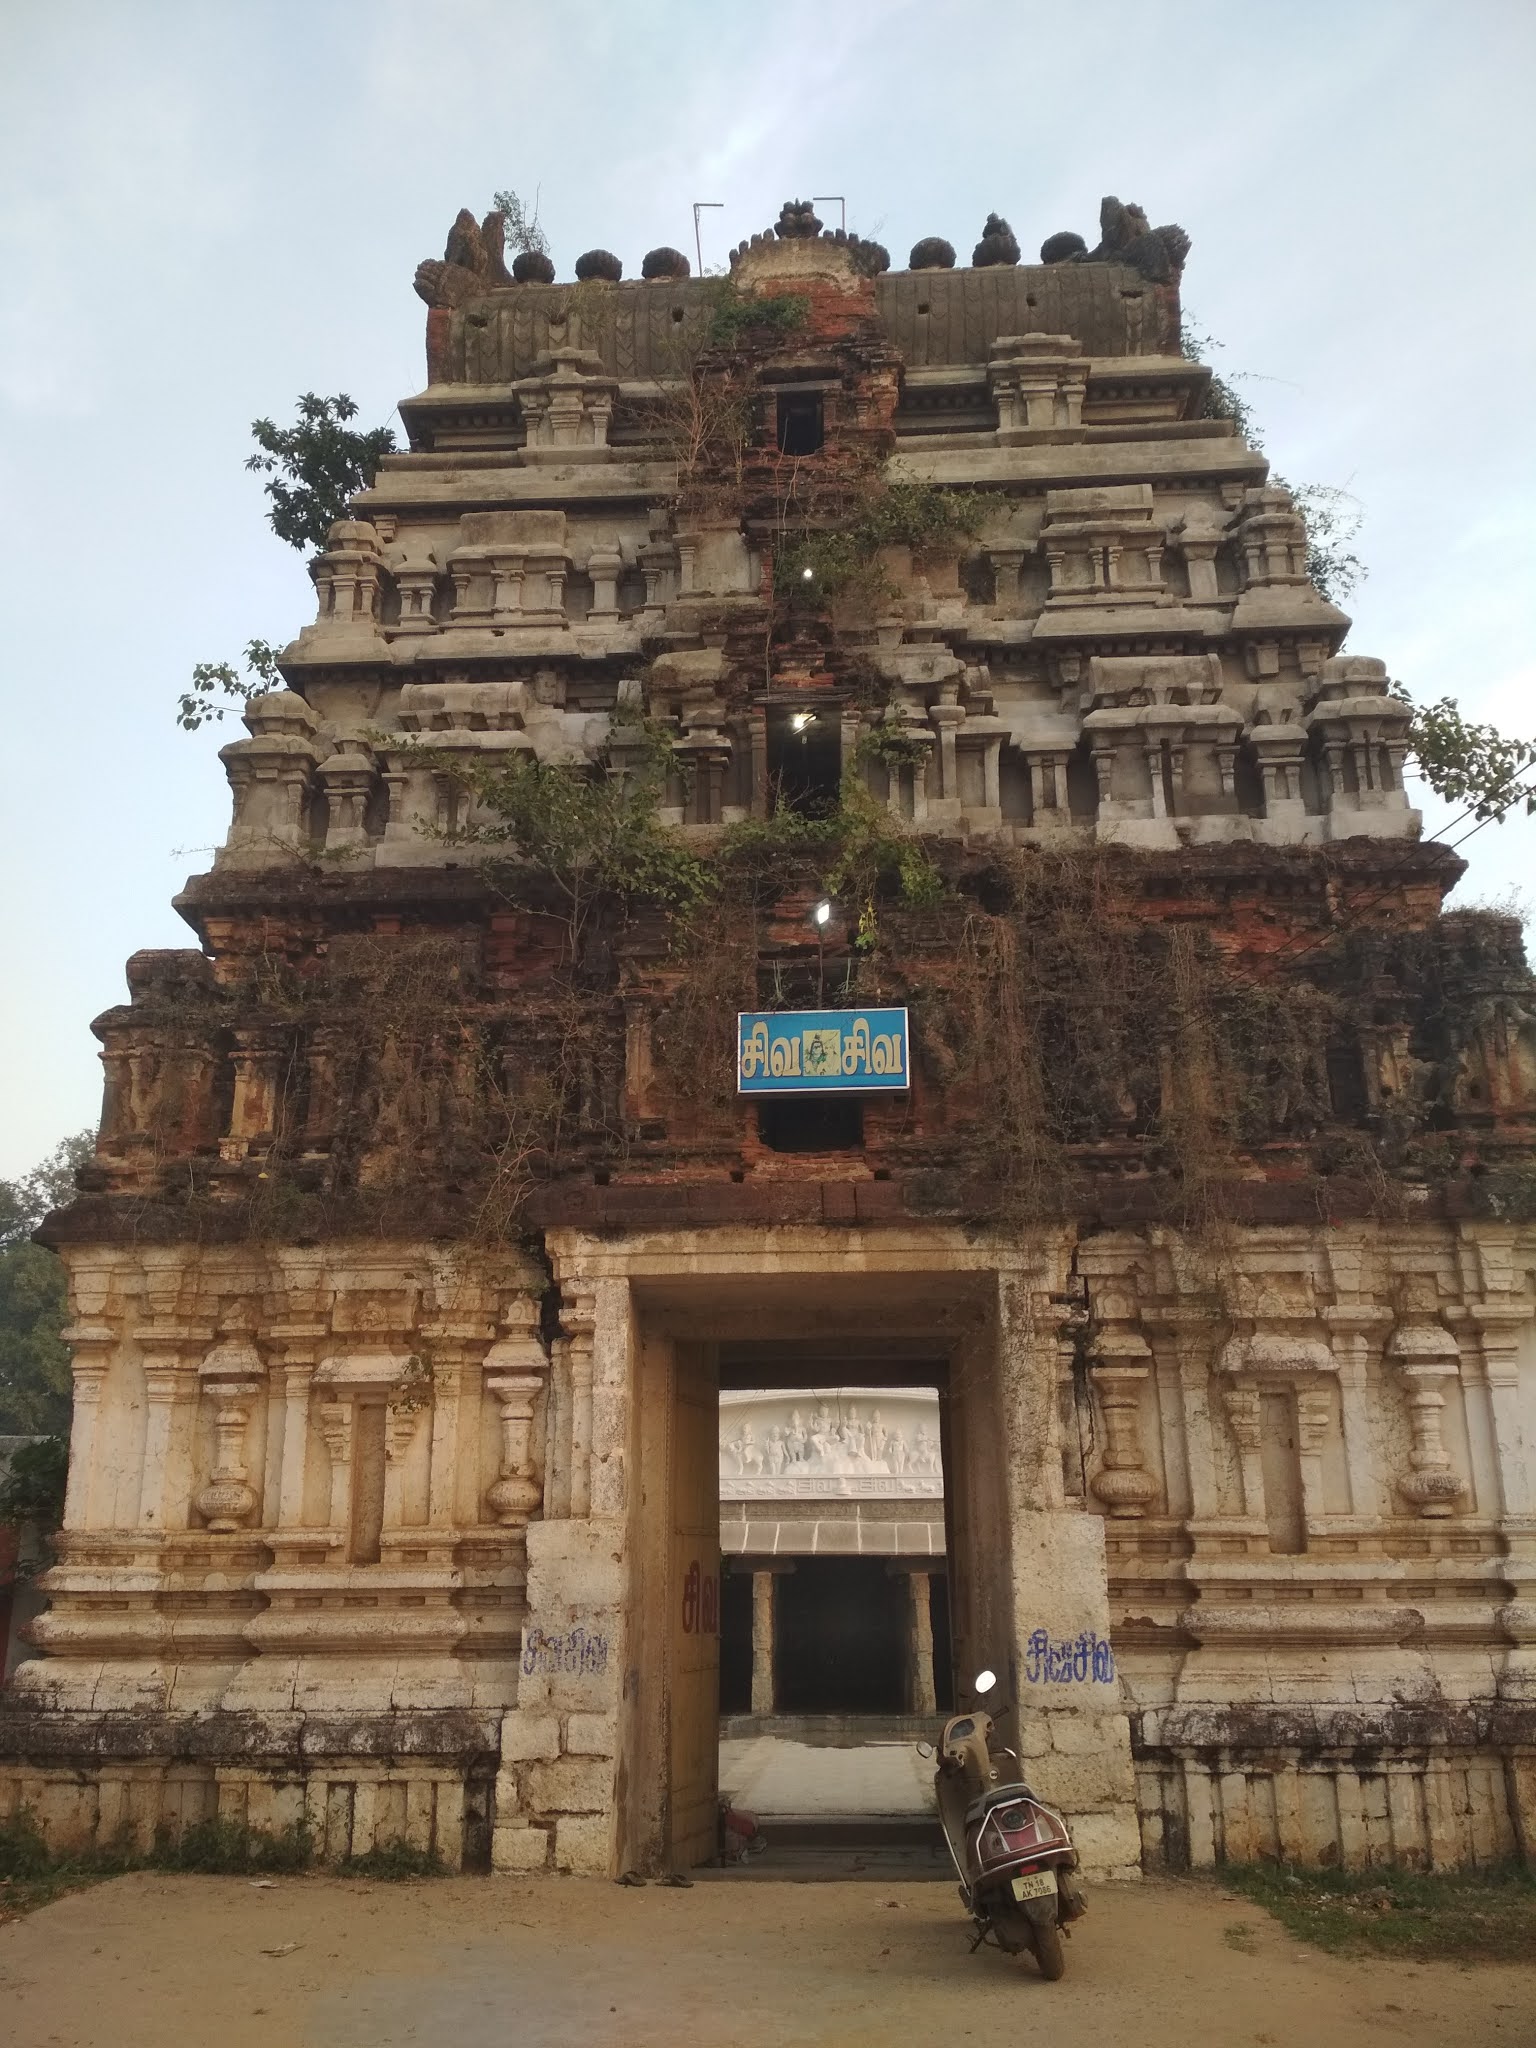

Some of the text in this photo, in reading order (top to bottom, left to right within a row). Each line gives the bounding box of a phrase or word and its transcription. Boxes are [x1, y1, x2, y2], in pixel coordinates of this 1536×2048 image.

[742, 1017, 903, 1078] சிவ சிவ
[1023, 1879, 1045, 1890] TN 18
[1022, 1889, 1033, 1899] AK
